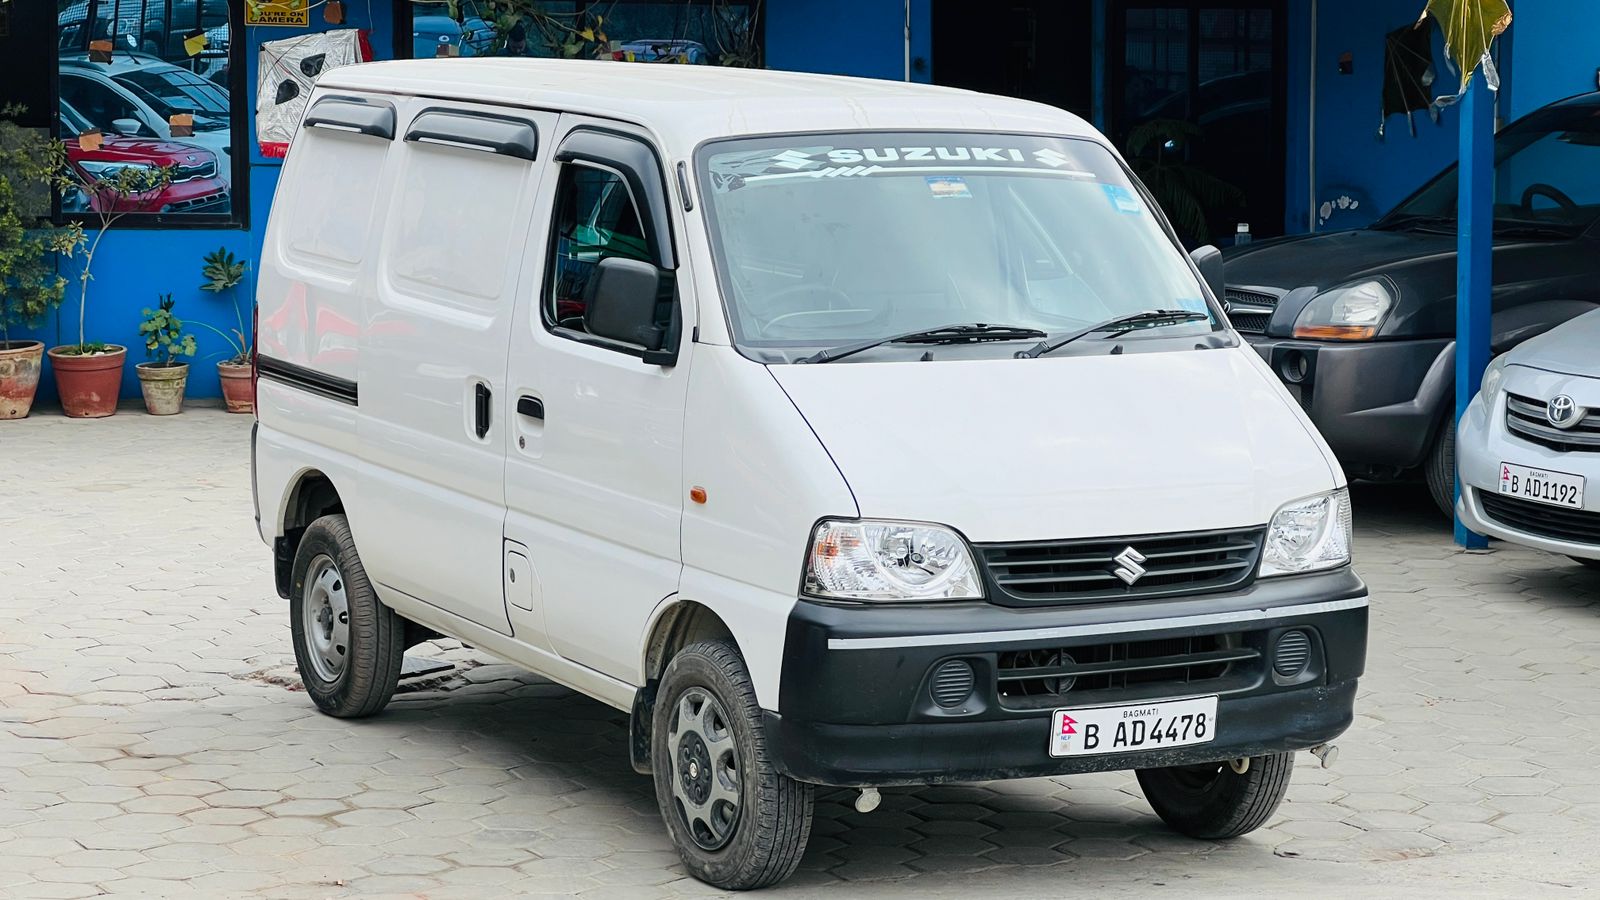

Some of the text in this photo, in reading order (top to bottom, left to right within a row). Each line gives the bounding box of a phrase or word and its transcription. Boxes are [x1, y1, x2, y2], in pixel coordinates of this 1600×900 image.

[827, 147, 1025, 163] SUZUKI
[1512, 475, 1577, 504] B AD1192
[1123, 708, 1159, 719] BAGMATI
[1084, 713, 1206, 750] B AD4478
